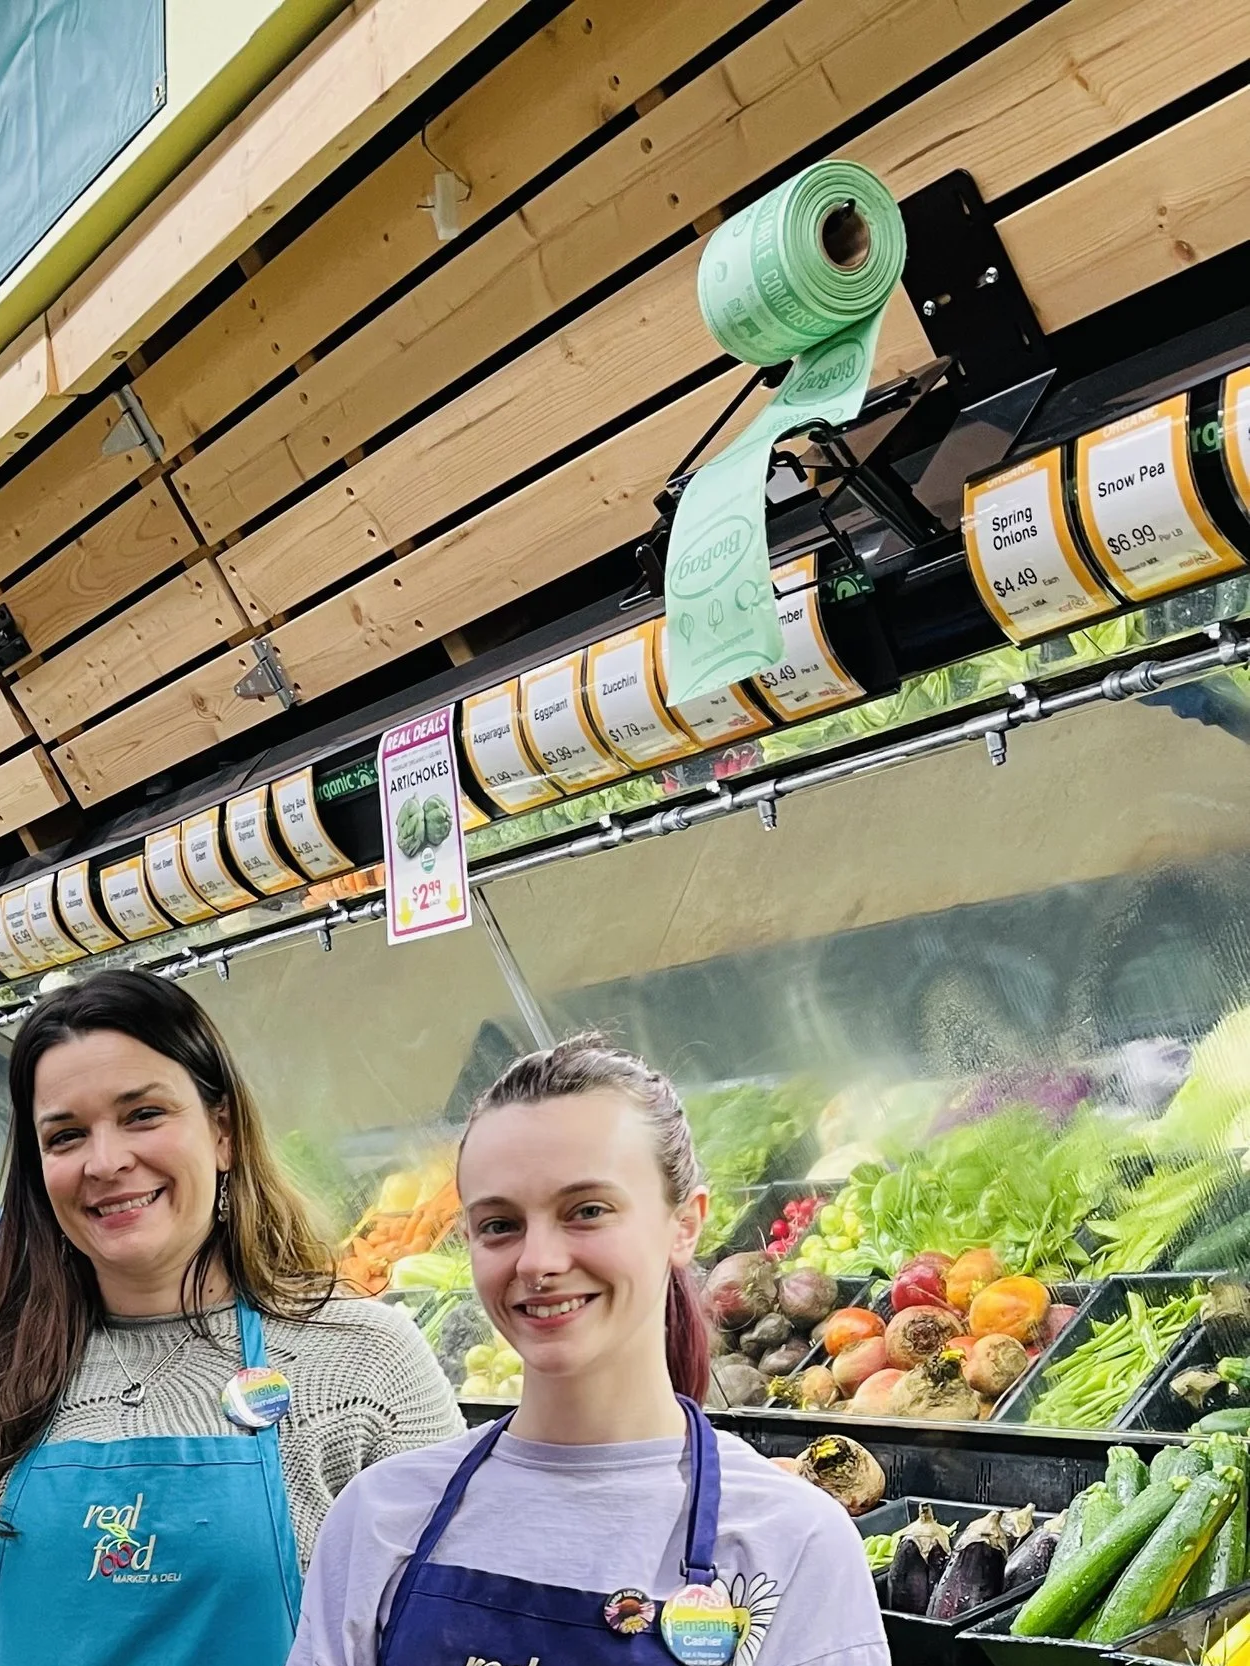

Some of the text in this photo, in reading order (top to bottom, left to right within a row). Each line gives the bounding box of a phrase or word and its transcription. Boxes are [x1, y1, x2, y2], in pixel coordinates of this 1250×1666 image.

[796, 353, 856, 392] BioBag
[1098, 462, 1166, 498] Snow Pea
[992, 507, 1033, 533] Spring
[993, 525, 1038, 551] Onions
[1107, 524, 1157, 556] $6.99
[678, 530, 742, 580] BioBag
[994, 568, 1038, 598] $4.49
[778, 607, 804, 626] mber
[602, 672, 637, 696] Zucchini
[759, 664, 797, 689] $3.49
[534, 698, 568, 722] Eggplant
[385, 729, 411, 752] REAL
[412, 714, 447, 743] DEALS
[473, 723, 511, 745] Asparagus
[609, 723, 641, 743] $1.79
[542, 746, 573, 766] $3.99
[390, 760, 449, 795] ARTICHOKES
[290, 813, 305, 825] Choy
[83, 1493, 143, 1530] real
[87, 1534, 156, 1580] food
[113, 1573, 182, 1583] MARKET & DELI
[623, 1590, 643, 1600] LOCAL
[665, 1619, 740, 1633] amantha
[683, 1635, 723, 1647] Cashier
